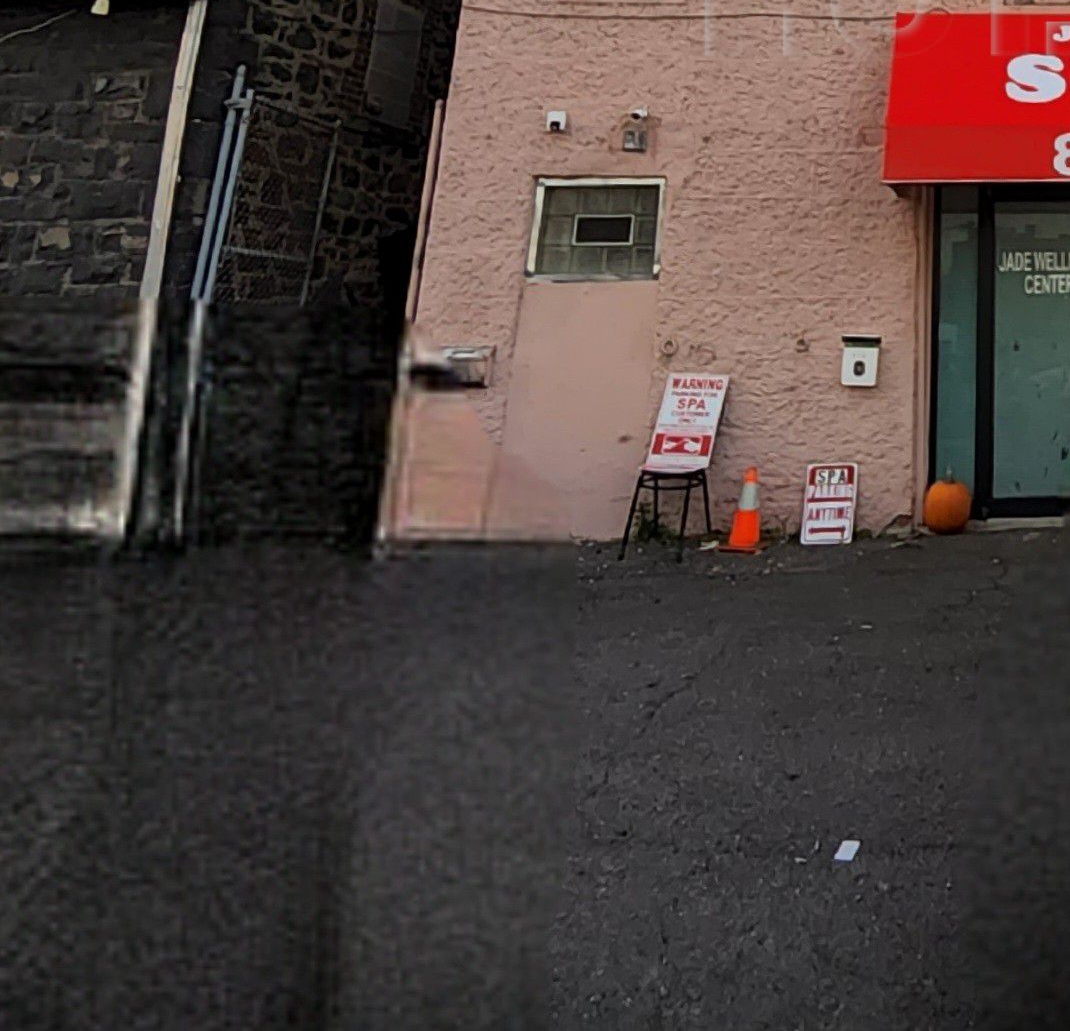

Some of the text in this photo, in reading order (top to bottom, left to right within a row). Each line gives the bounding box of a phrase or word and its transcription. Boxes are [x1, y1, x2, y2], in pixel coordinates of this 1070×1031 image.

[999, 251, 1032, 272] JADE
[672, 378, 724, 391] WARNING
[677, 397, 706, 411] SPA
[816, 469, 847, 484] SPA
